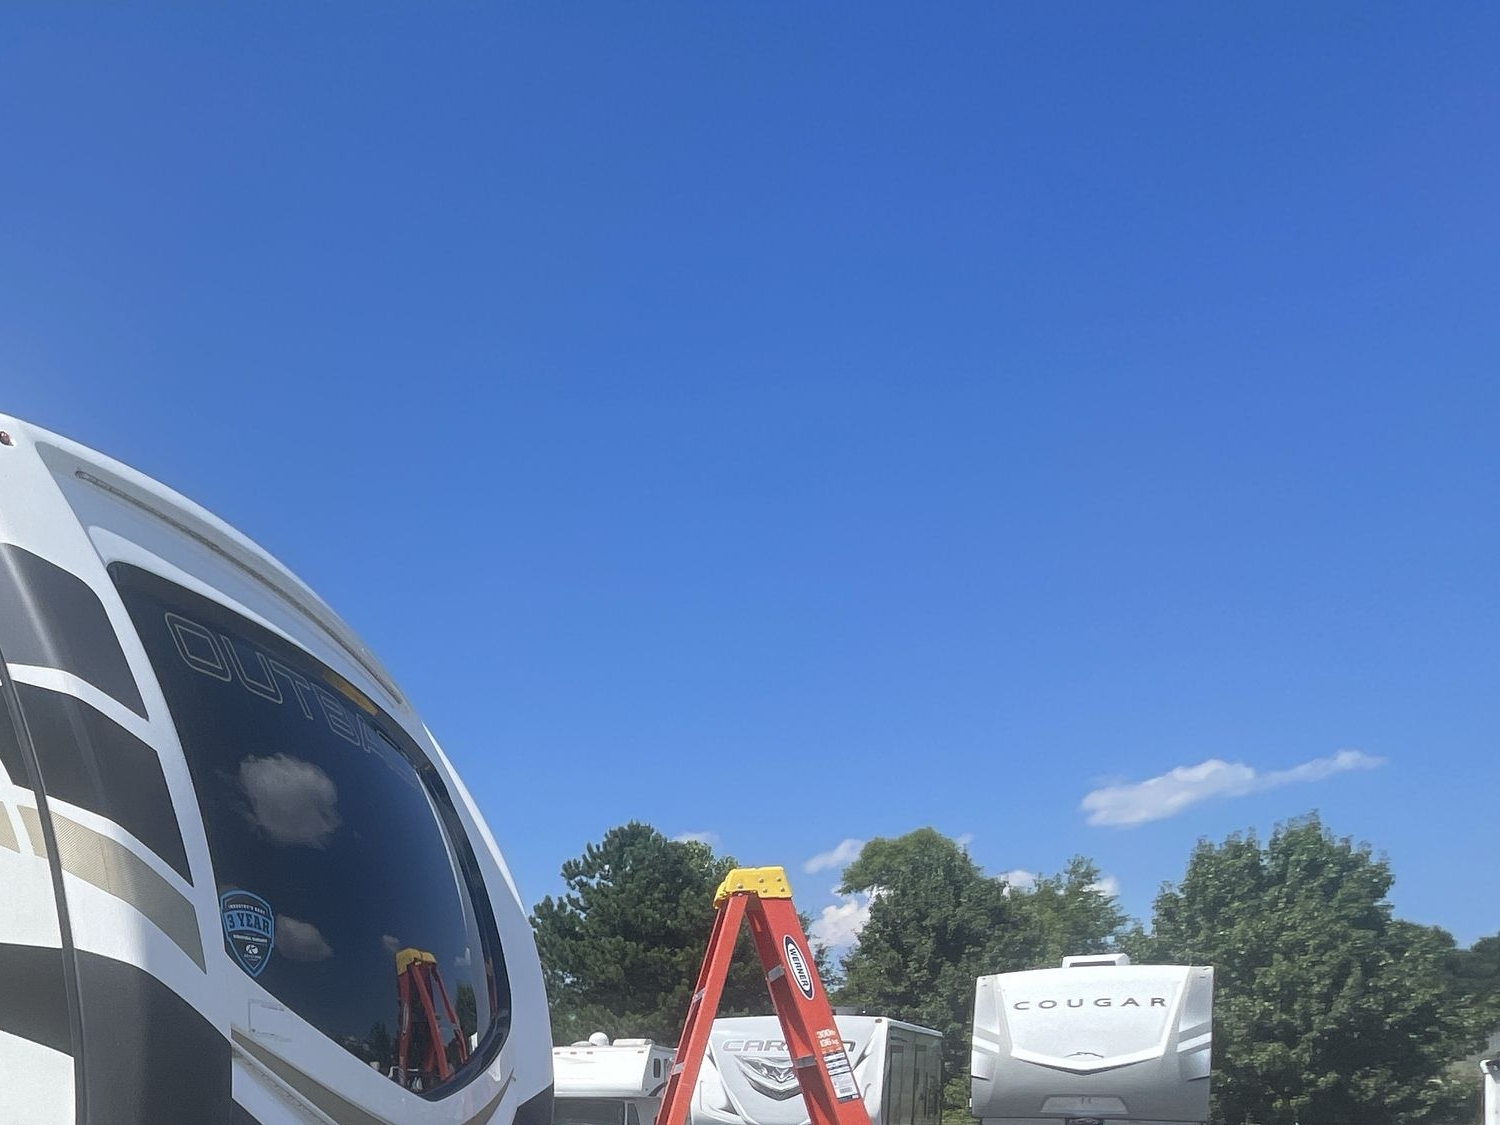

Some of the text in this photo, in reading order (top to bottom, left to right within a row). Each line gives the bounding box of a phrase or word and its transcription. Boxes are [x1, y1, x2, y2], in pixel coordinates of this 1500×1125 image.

[227, 912, 270, 935] 3 YEAR
[789, 947, 810, 987] WERNER
[1013, 997, 1167, 1011] COUGAR
